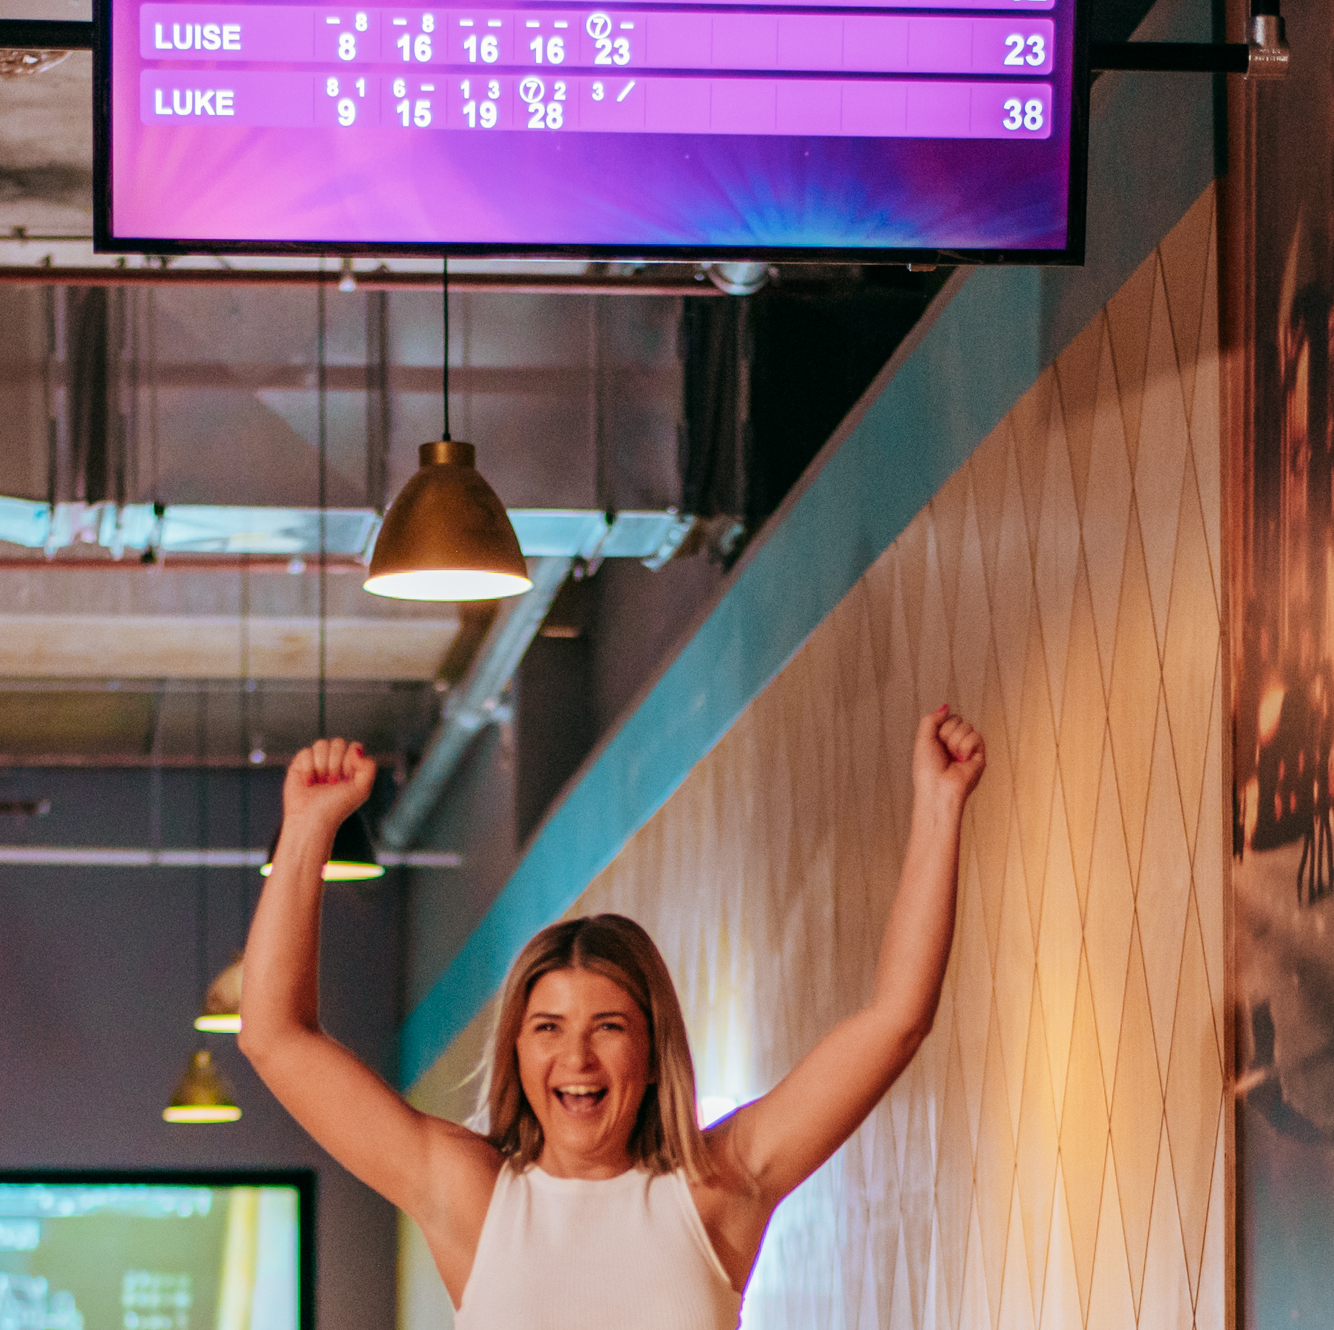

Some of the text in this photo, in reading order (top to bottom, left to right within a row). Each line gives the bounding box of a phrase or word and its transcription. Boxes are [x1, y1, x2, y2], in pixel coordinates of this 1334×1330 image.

[354, 12, 367, 32] 8
[421, 13, 434, 33] 8
[154, 23, 1046, 67] LUISE 8 16 16 16 23 23
[326, 77, 340, 97] 8
[355, 78, 365, 98] 1
[393, 79, 406, 98] 6
[461, 80, 470, 99] 1
[488, 80, 501, 99] 3
[554, 81, 567, 101] 2
[592, 82, 605, 101] 3
[155, 89, 1044, 131] LUKE 9 15 19 28 38
